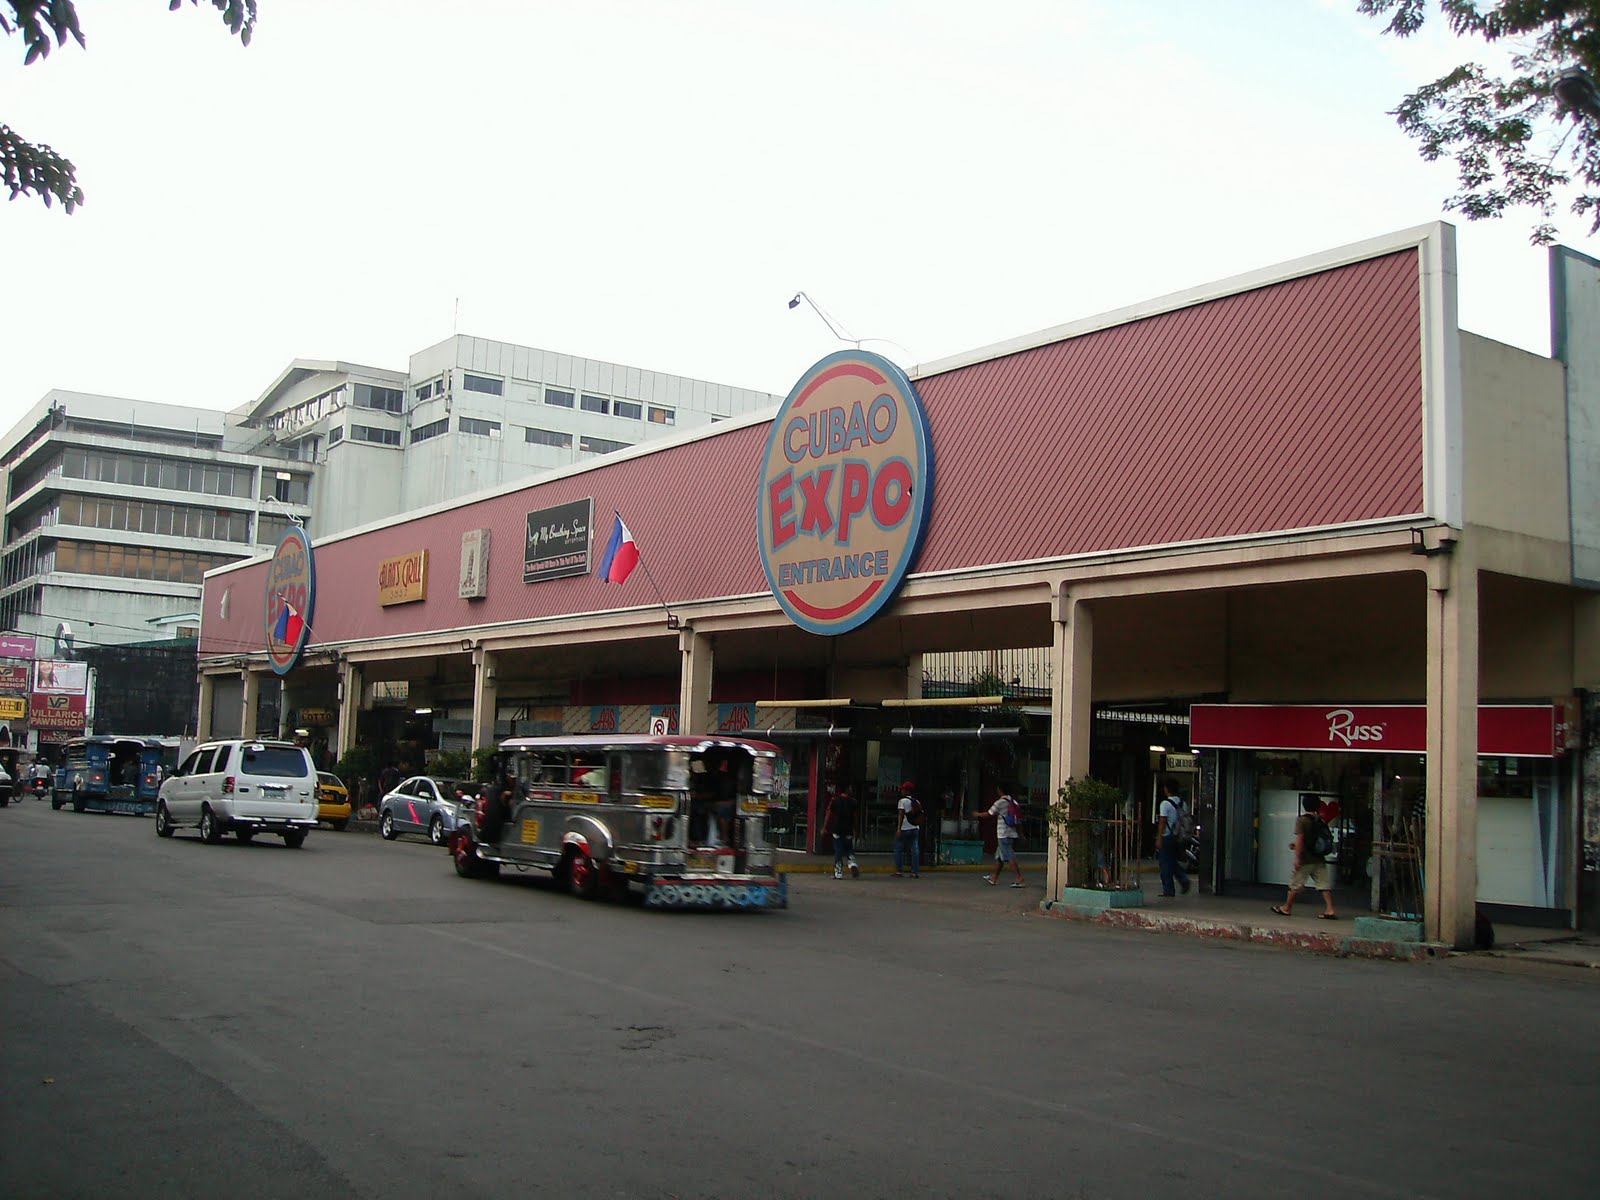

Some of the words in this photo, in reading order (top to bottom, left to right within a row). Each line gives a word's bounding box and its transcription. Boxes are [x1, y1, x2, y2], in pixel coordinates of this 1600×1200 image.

[783, 393, 898, 464] CUBAO
[769, 457, 915, 553] EXPO
[571, 518, 587, 538] Space
[274, 550, 305, 582] CUBAO
[402, 555, 421, 588] GRILL
[778, 550, 889, 587] ENTRANCE
[31, 708, 84, 719] VILLARICA
[48, 696, 68, 709] VP
[30, 717, 84, 727] PAWNSHOP
[1326, 709, 1383, 747] Russ
